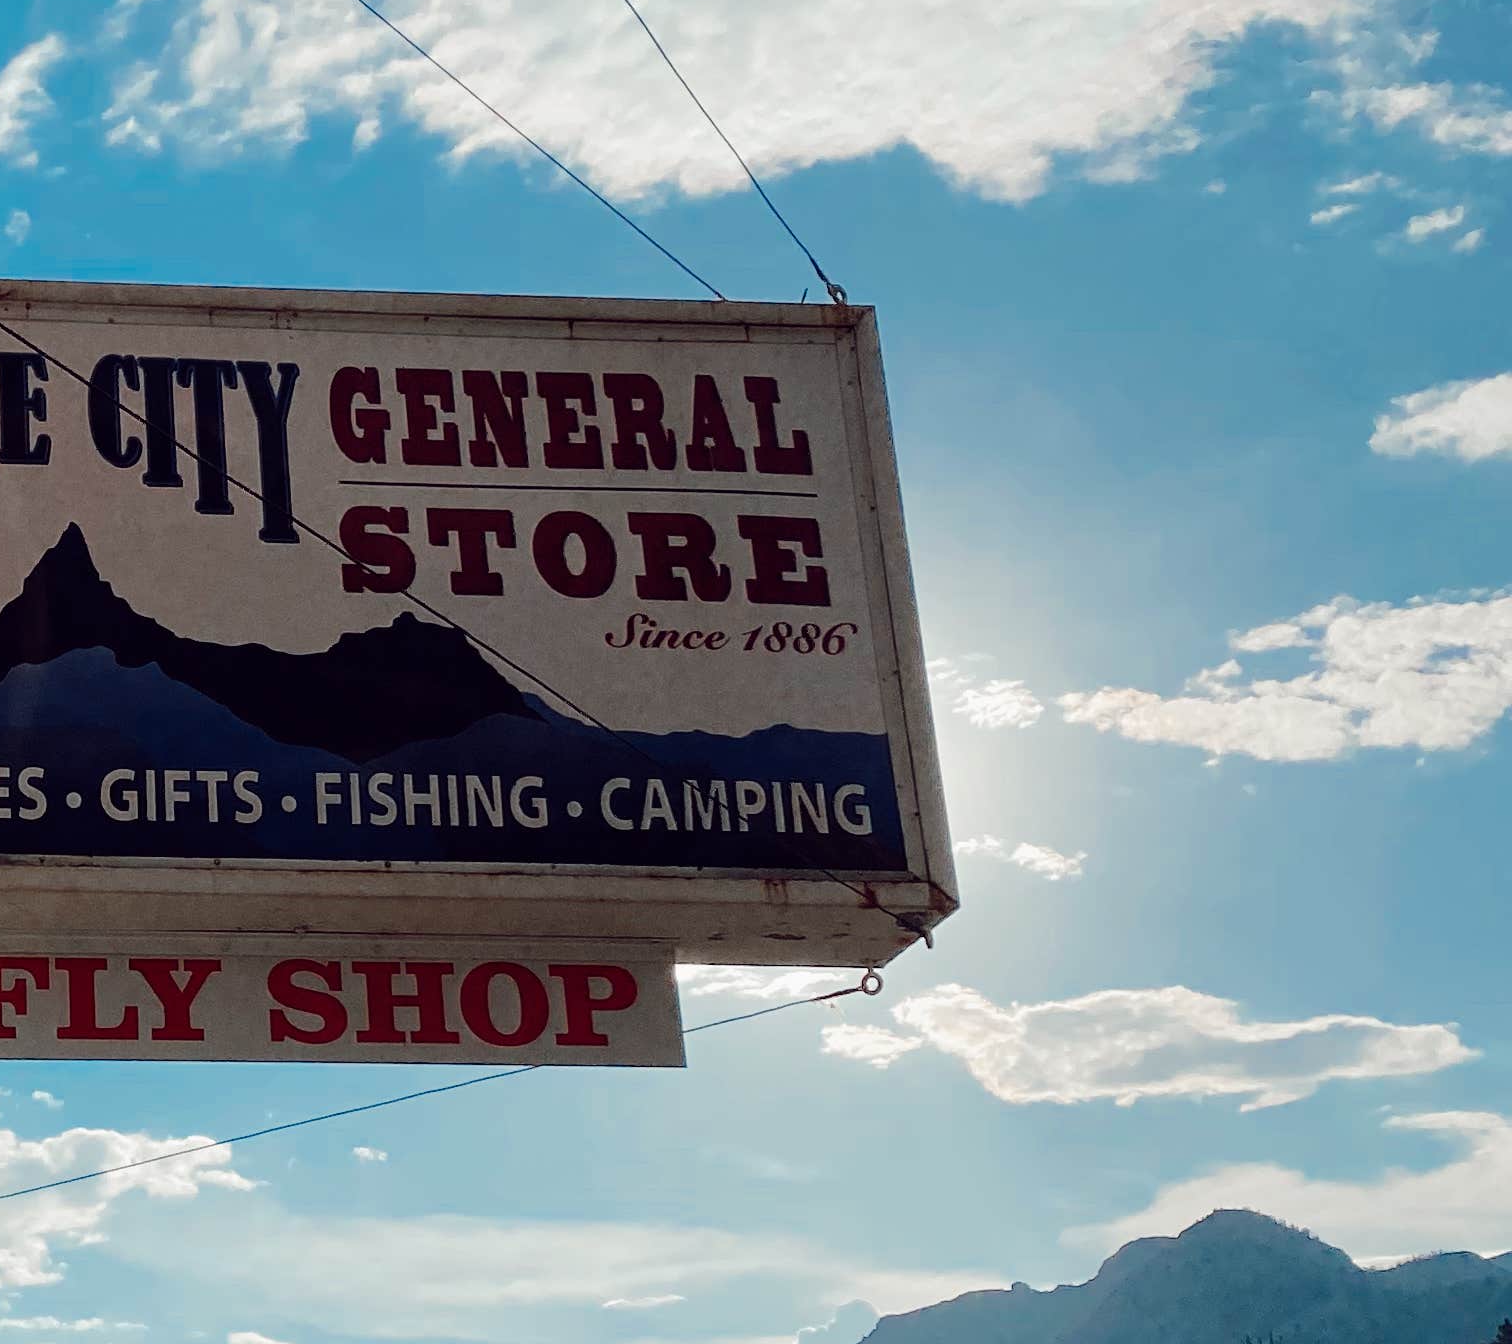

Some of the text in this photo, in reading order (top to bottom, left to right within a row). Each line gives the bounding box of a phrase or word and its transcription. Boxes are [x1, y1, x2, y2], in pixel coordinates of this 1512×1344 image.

[87, 352, 300, 545] CITY
[328, 365, 814, 477] GENERAL
[340, 505, 833, 608] STORE
[604, 613, 859, 656] Since 1886
[98, 769, 264, 825] GIFTS
[315, 772, 551, 829] FISHING
[600, 777, 873, 837] CAMPING
[267, 959, 639, 1049] SHOP
